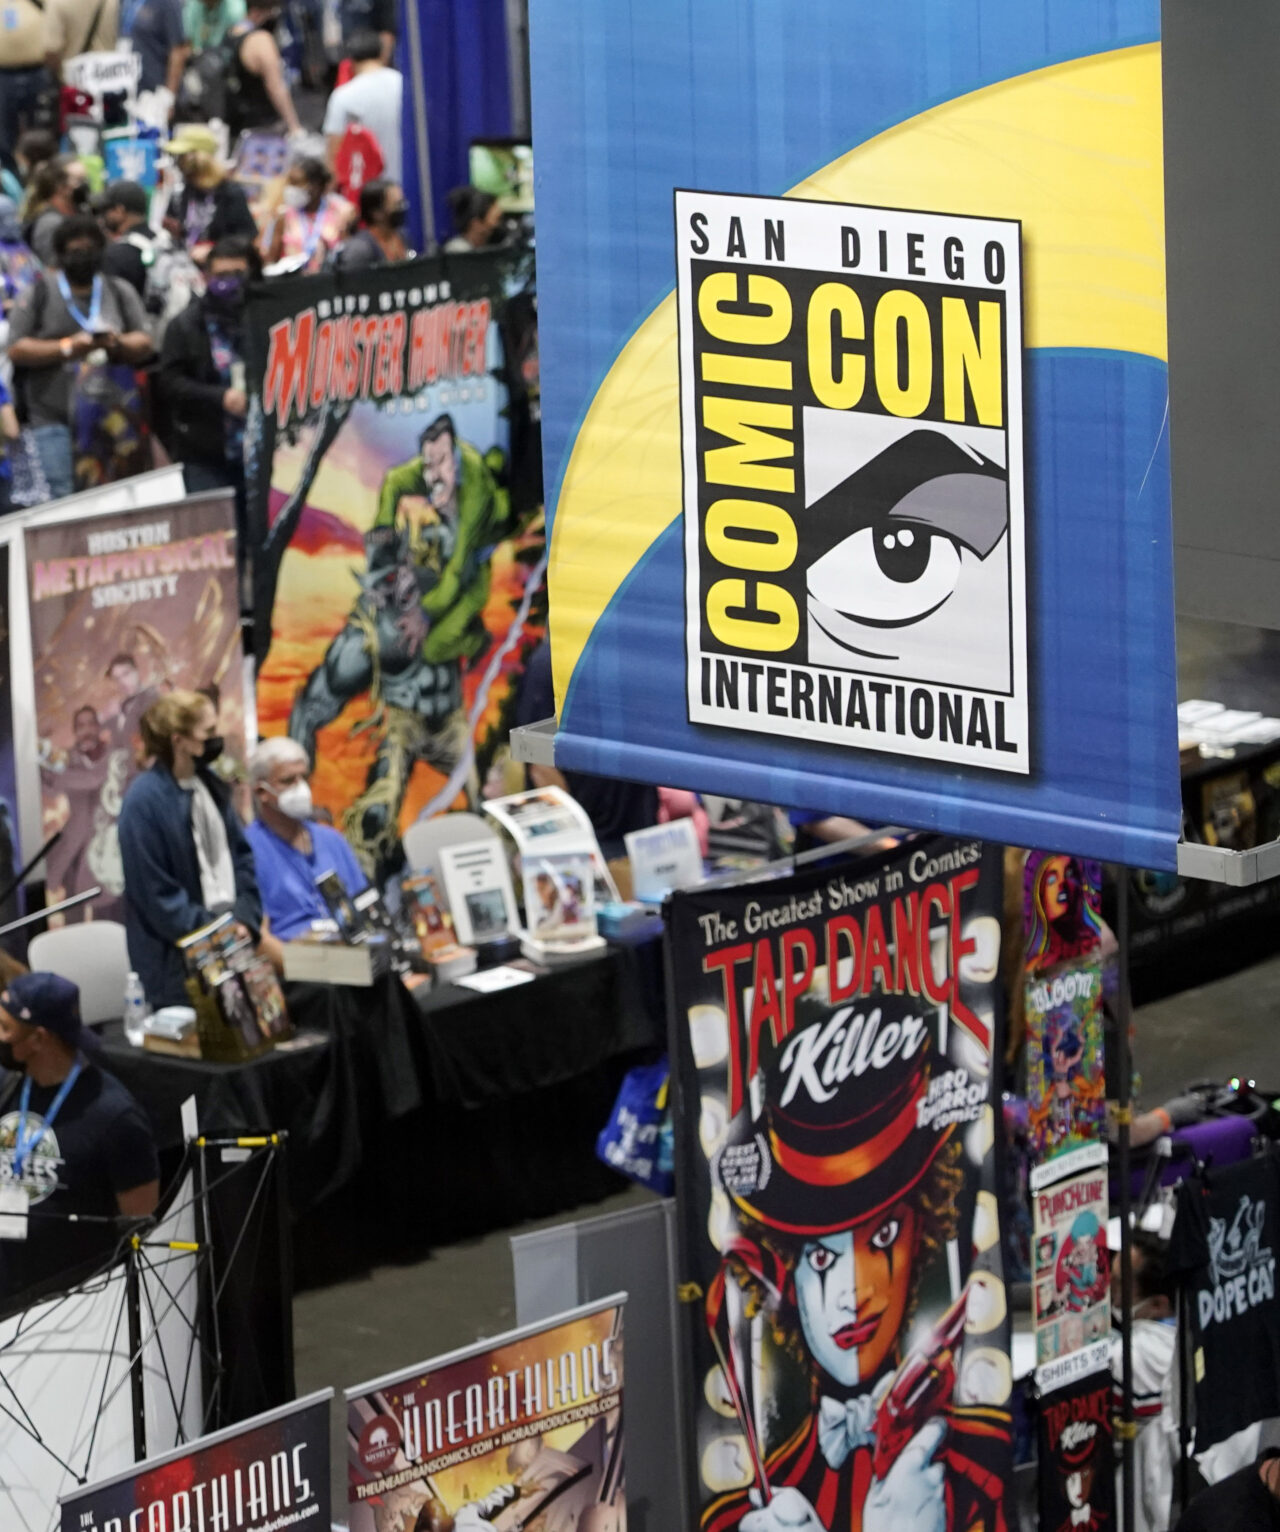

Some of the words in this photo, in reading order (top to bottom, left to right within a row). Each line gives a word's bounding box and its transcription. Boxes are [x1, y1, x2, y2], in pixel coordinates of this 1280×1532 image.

[689, 212, 786, 262] SAN
[840, 225, 1006, 285] DIEGO
[263, 308, 408, 430] MONSTER
[407, 297, 491, 392] HUNTER
[806, 281, 1004, 428] CON
[697, 271, 801, 654] COMIC
[700, 656, 1018, 754] INTERNATIONAL
[699, 912, 739, 946] The
[743, 888, 824, 934] Greatest
[827, 874, 880, 911] Show
[884, 865, 904, 893] in
[703, 927, 818, 1123] TAP
[825, 868, 992, 1057] DANCE
[779, 1005, 928, 1108] Killer
[403, 1338, 620, 1461] UNEARTHIANS
[1042, 1352, 1089, 1382] SHIRTS
[79, 1443, 308, 1532] ARTHIANS
[80, 1510, 94, 1527] THE
